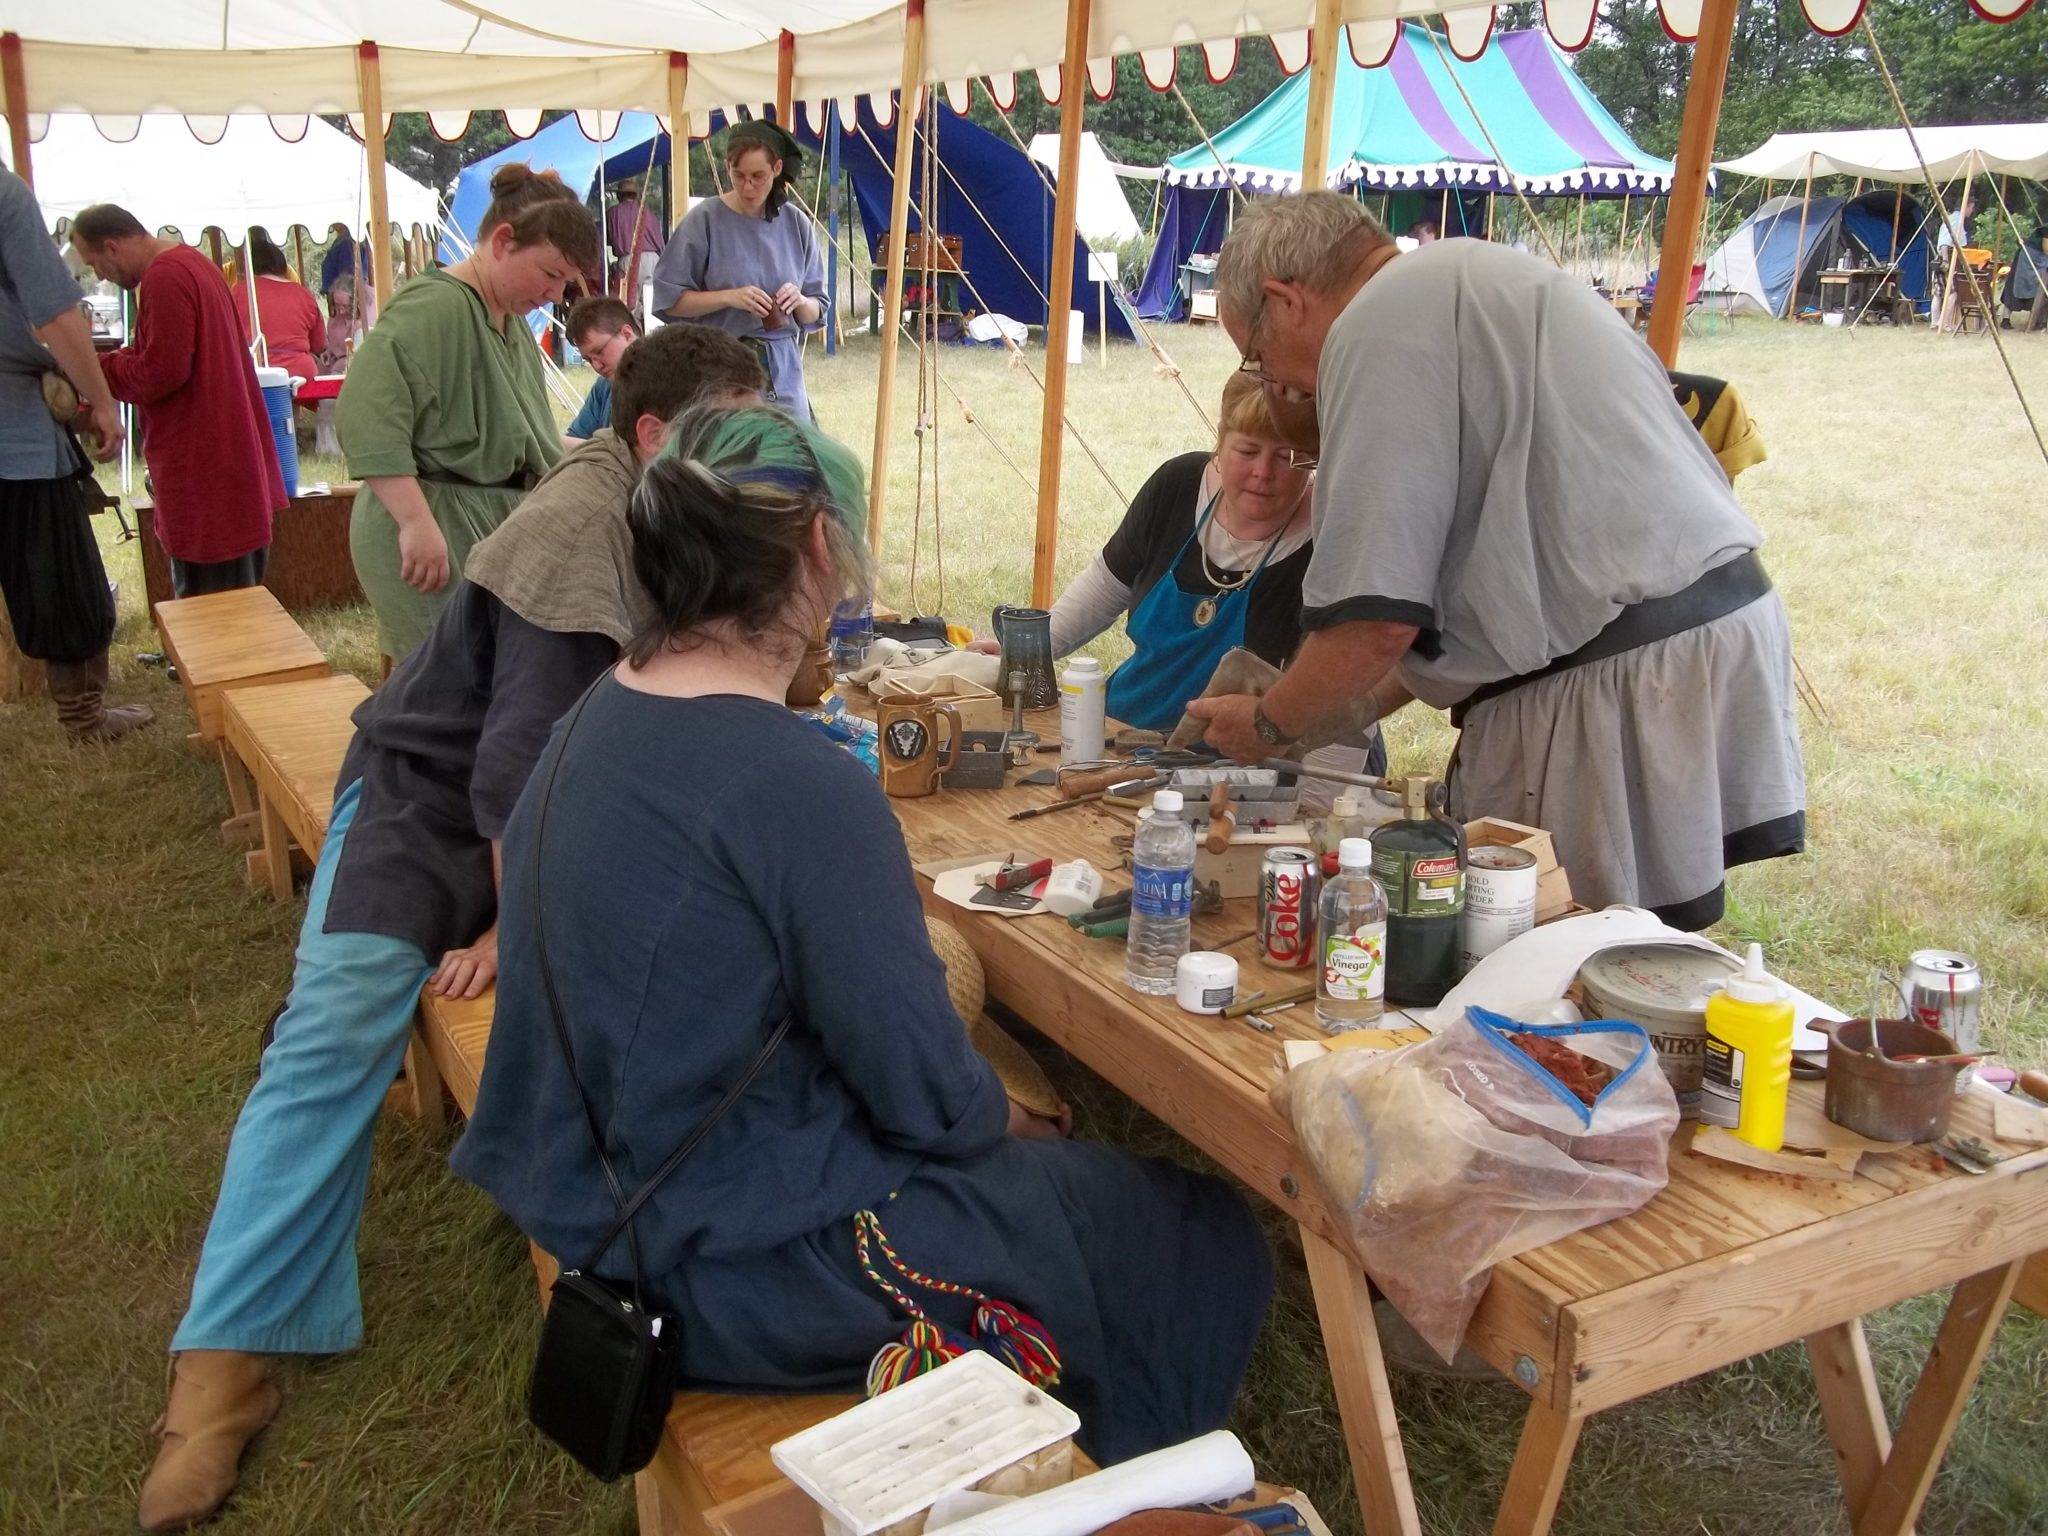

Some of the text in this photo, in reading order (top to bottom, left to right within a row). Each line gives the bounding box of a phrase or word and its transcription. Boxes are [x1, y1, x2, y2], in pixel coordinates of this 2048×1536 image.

[1416, 861, 1453, 874] Coleman
[1268, 873, 1300, 961] Coke
[1332, 957, 1369, 972] Vinegar
[1465, 1060, 1489, 1084] LOSED
